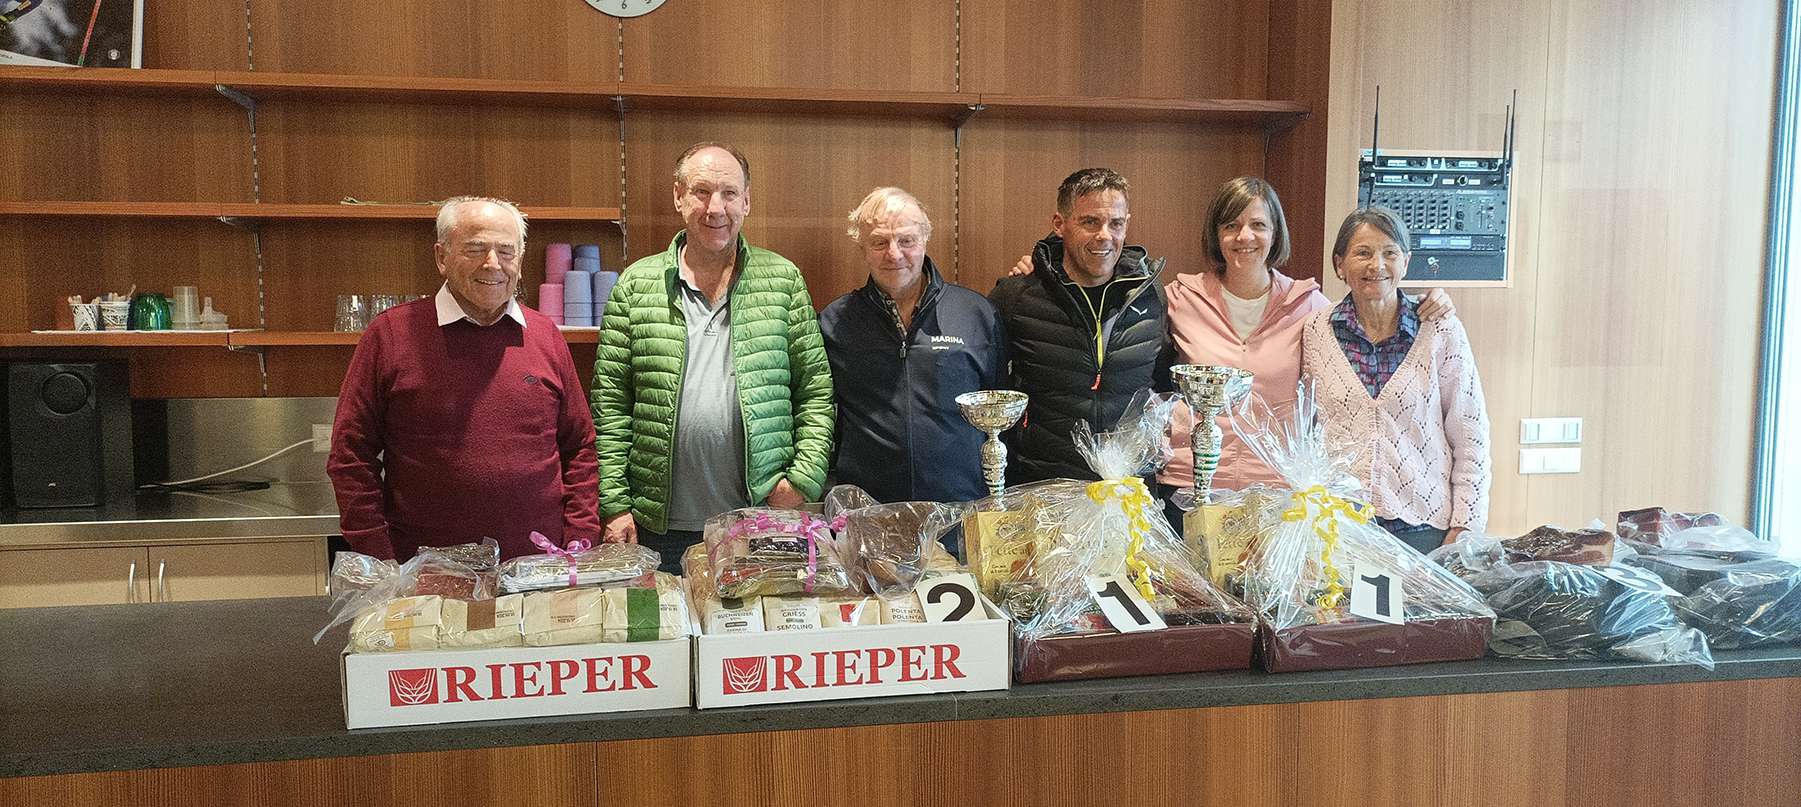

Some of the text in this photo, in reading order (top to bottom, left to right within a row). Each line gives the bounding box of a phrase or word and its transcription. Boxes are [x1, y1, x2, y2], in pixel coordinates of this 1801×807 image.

[931, 336, 964, 344] MARINA
[927, 583, 975, 622] 2
[1099, 581, 1151, 626] 1
[1361, 574, 1390, 617] 1
[776, 623, 813, 631] SEMOLINO
[441, 654, 657, 702] RIEPER
[771, 644, 966, 691] RIEPER
